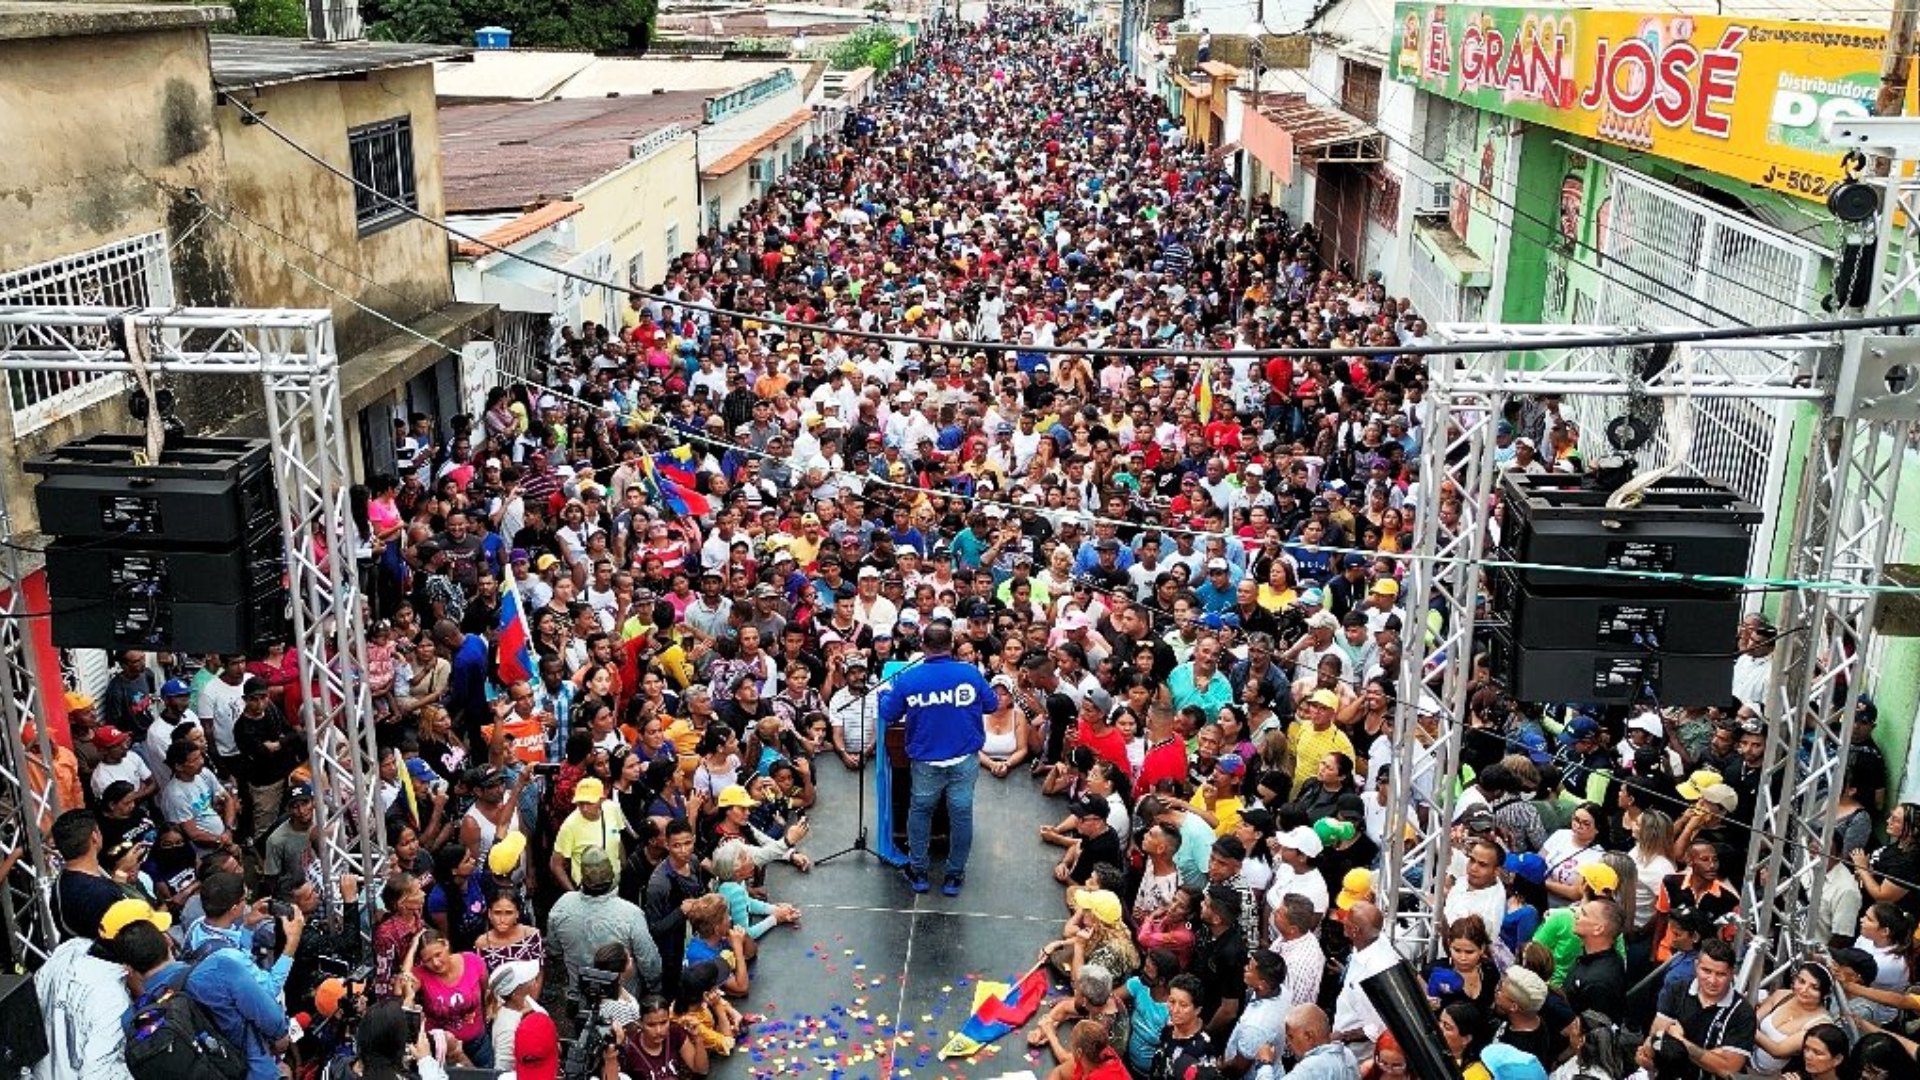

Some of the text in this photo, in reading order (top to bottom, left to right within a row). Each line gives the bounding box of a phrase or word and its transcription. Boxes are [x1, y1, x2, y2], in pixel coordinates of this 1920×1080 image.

[1428, 22, 1748, 138] EL GRAN JOSÉ
[1778, 71, 1878, 101] Distribuidora
[906, 683, 976, 708] PLAN B
